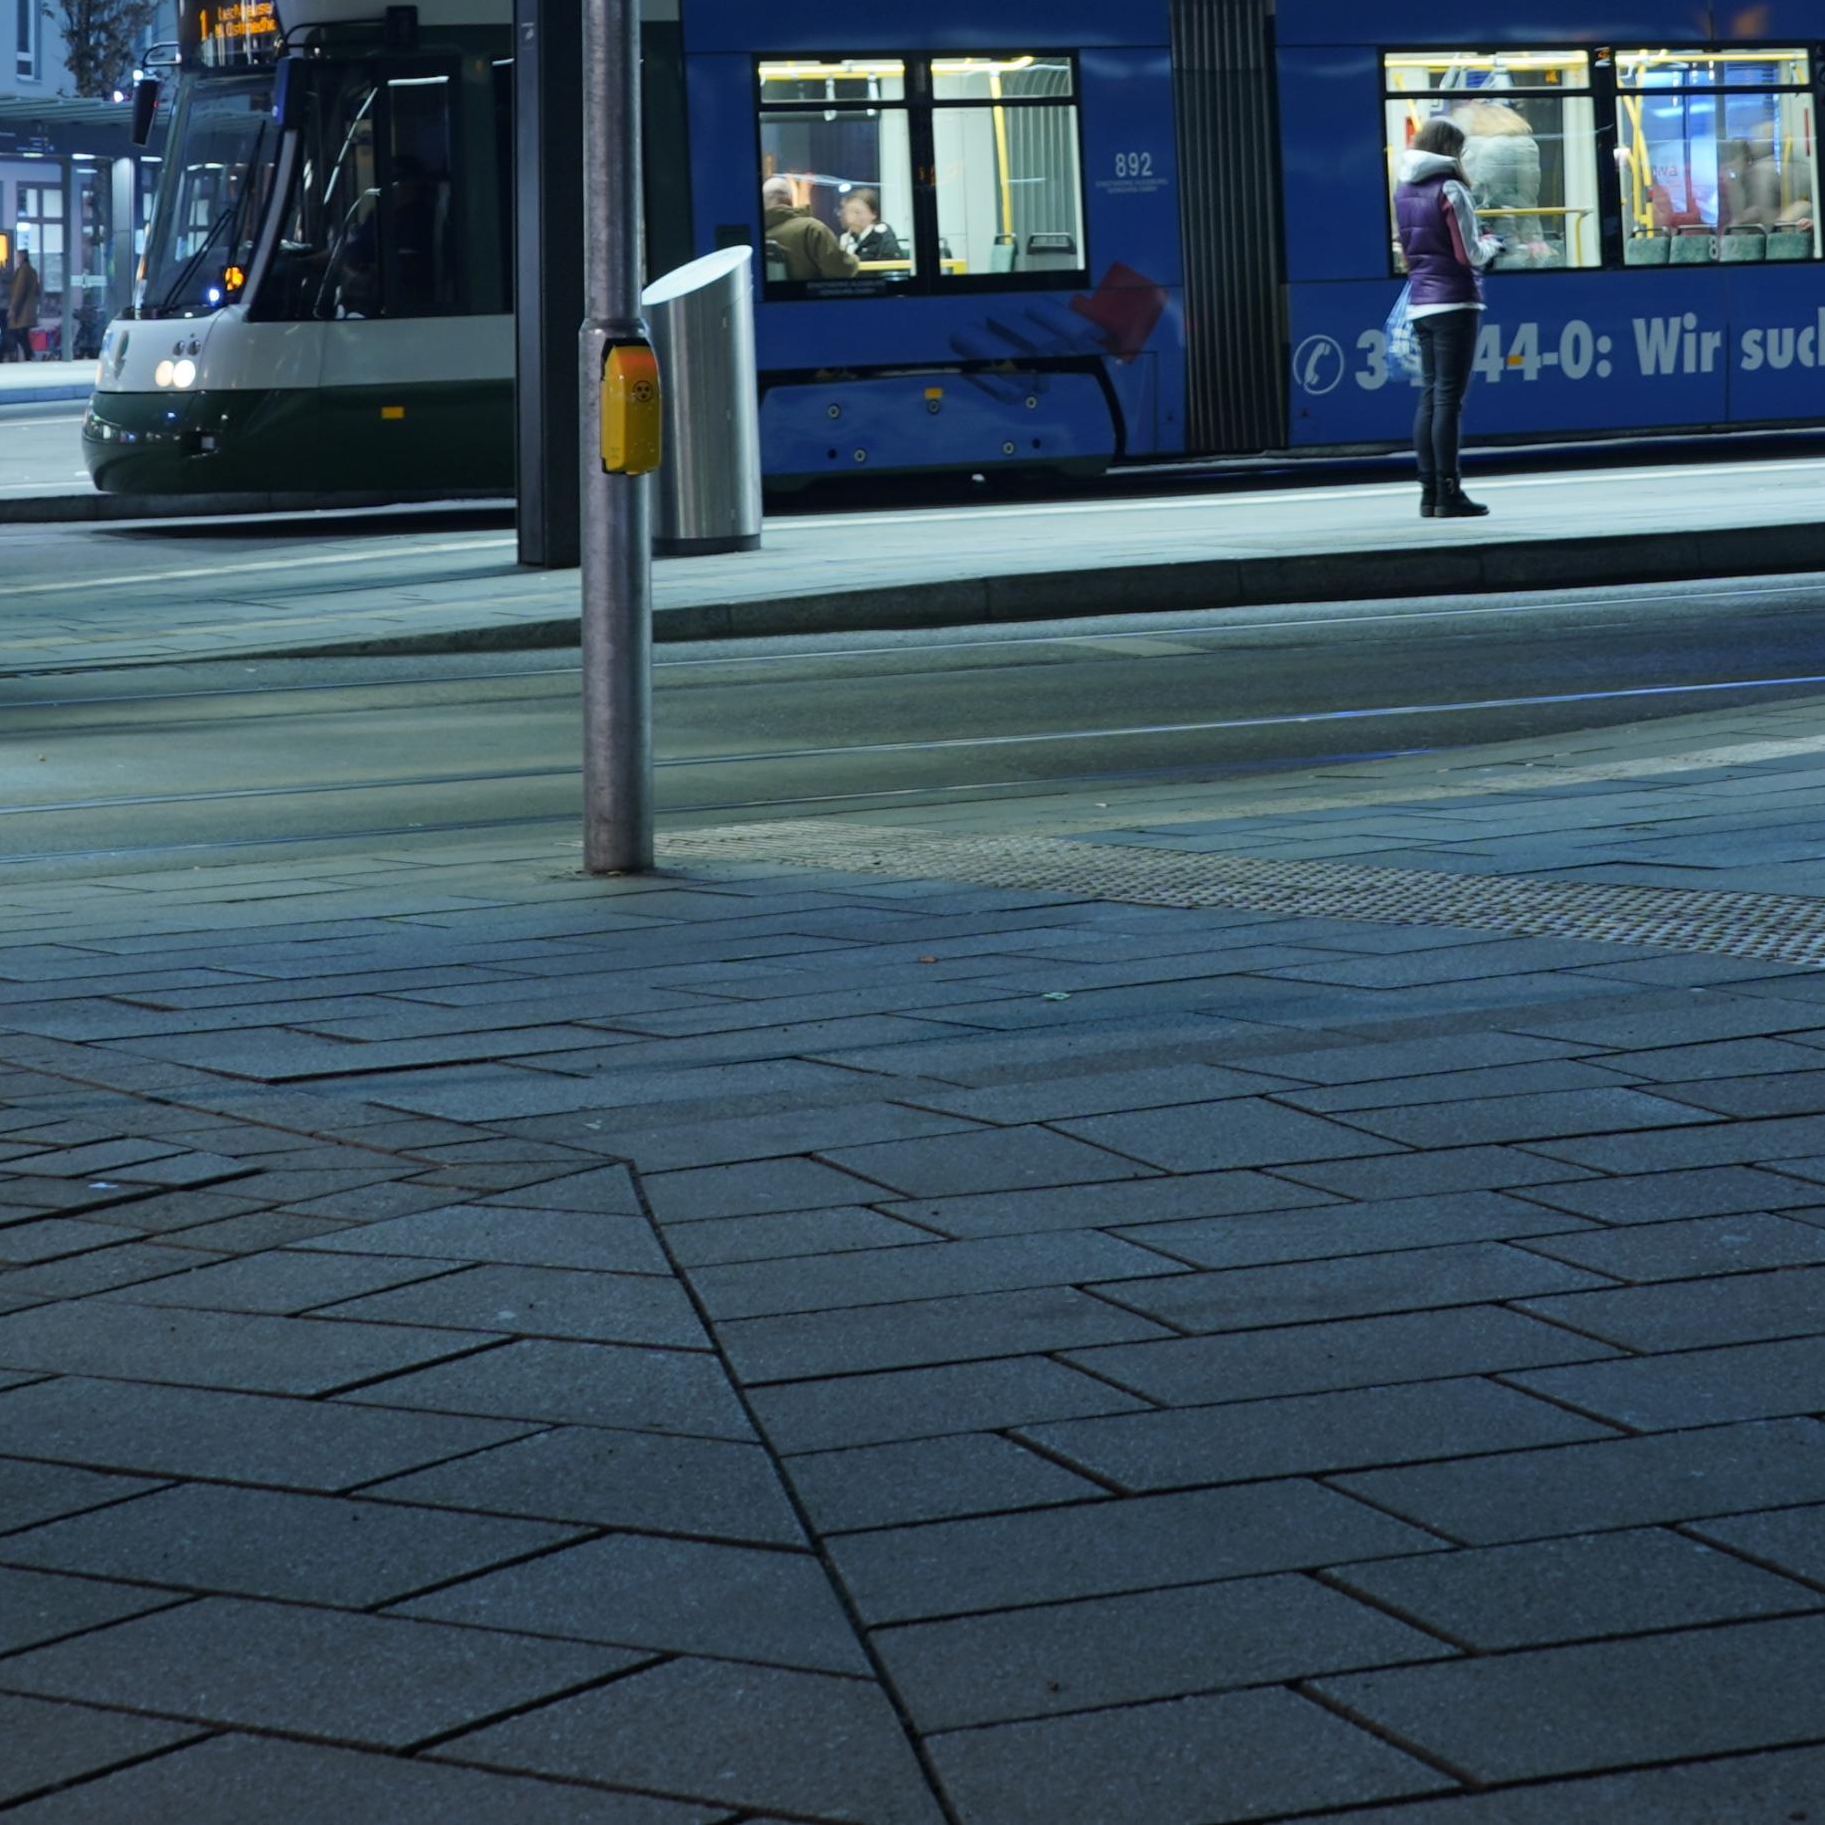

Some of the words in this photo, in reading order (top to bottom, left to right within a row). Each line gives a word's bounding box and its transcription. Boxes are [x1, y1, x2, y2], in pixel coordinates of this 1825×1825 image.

[199, 9, 208, 42] 1
[1115, 152, 1153, 178] 892
[1355, 318, 1611, 391] 344-0:
[1631, 312, 1720, 377] Wir
